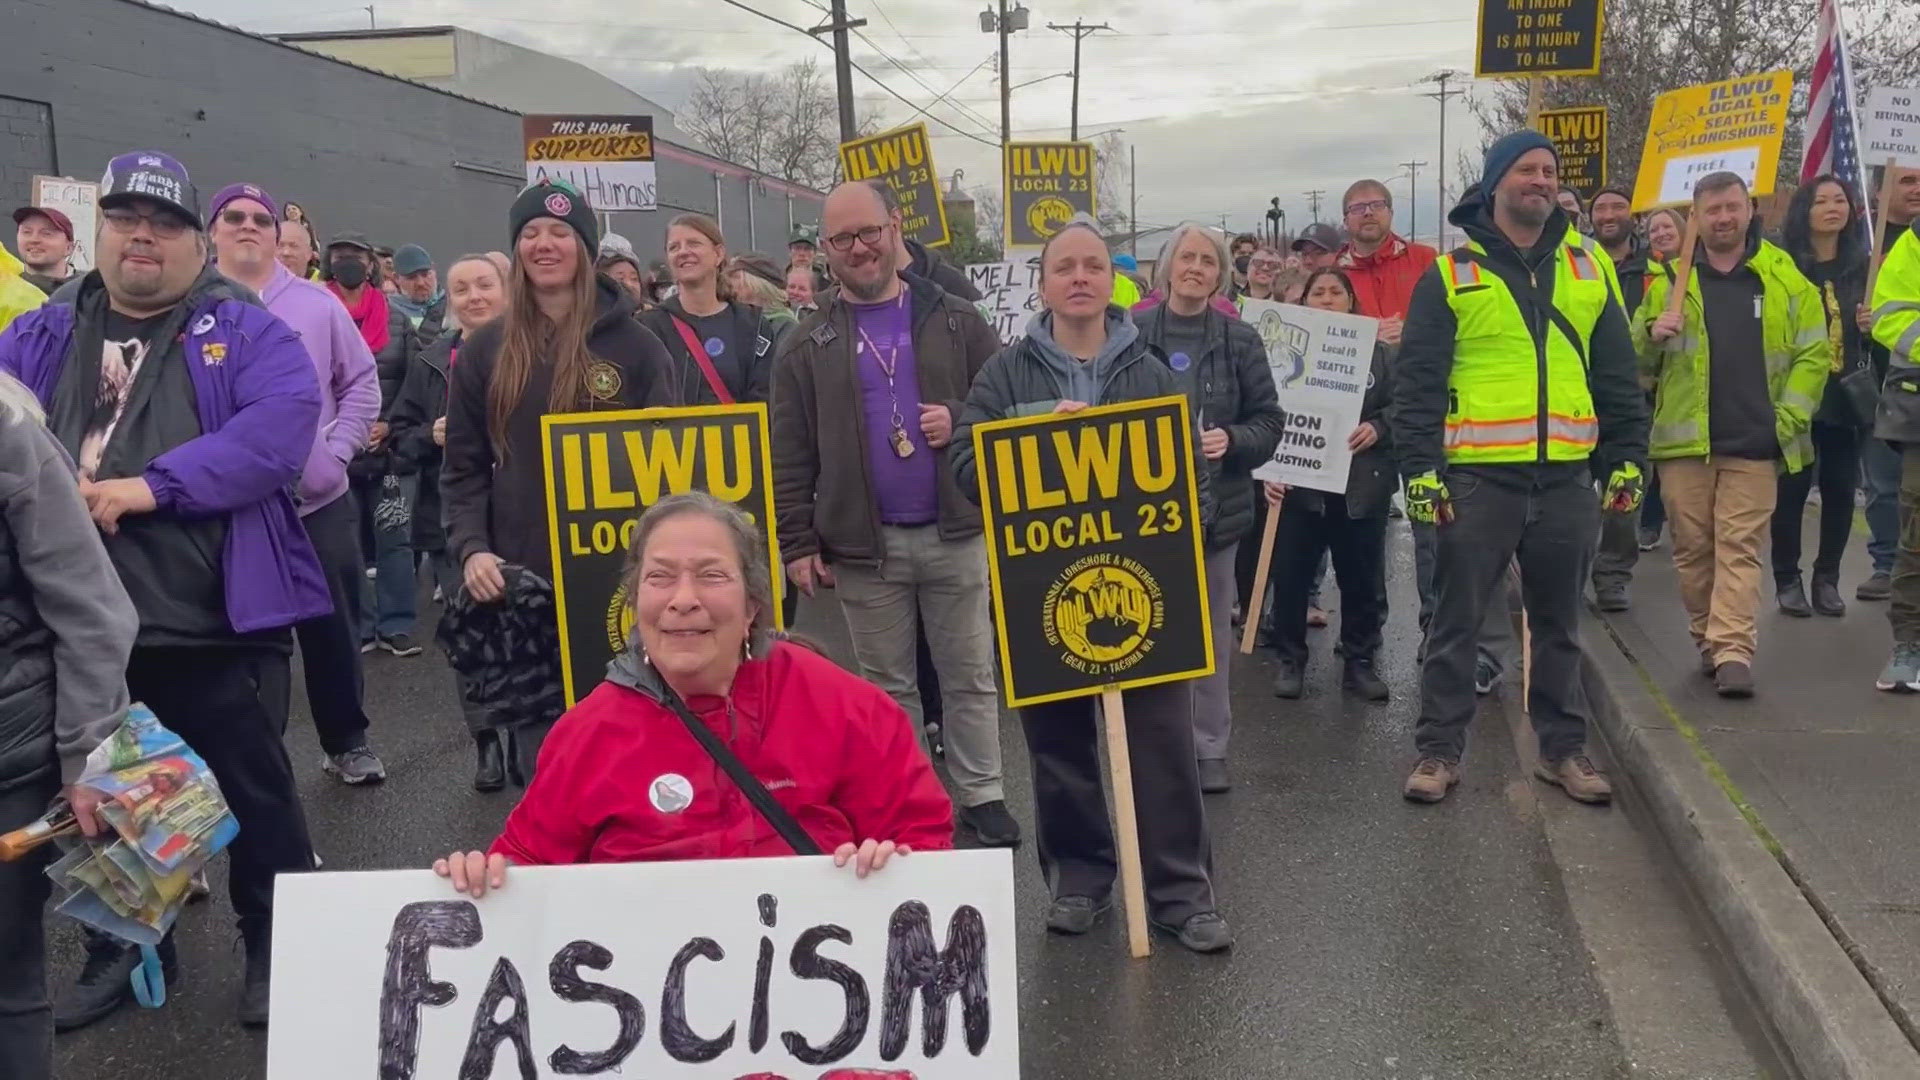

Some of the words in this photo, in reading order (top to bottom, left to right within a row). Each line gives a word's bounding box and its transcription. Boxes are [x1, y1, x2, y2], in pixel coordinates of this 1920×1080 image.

[1516, 14, 1532, 29] TO
[1537, 13, 1564, 28] ONE
[1497, 34, 1510, 48] IS
[1514, 33, 1531, 48] AN
[1536, 31, 1580, 47] INJURY
[1516, 52, 1532, 67] TO
[1536, 51, 1559, 65] ALL
[1711, 77, 1774, 102] ILWU
[1697, 99, 1756, 117] LOCAL
[1761, 93, 1781, 106] 19
[1892, 96, 1911, 107] NO
[551, 121, 586, 135] THIS
[587, 122, 633, 135] HOME
[1705, 109, 1768, 130] SEATTLE
[1690, 122, 1778, 146] LONGSHORE
[1890, 127, 1904, 138] IS
[531, 134, 648, 161] SUPPORTS
[848, 131, 924, 181] ILWU
[1584, 142, 1601, 154] 23
[1870, 141, 1919, 154] ILLEGAL
[1012, 148, 1087, 176] ILWU
[909, 168, 929, 185] 23
[1014, 179, 1063, 192] LOCAL
[1069, 179, 1089, 192] 23
[900, 190, 918, 204] URY
[1316, 360, 1356, 375] SEATTLE
[1305, 376, 1360, 394] LONGSHORE
[1287, 412, 1322, 430] ION
[1283, 431, 1327, 450] TING
[562, 423, 753, 511] ILWU
[993, 415, 1177, 515] ILWU
[1275, 453, 1322, 470] USTING
[1003, 509, 1124, 557] LOCAL
[1138, 499, 1183, 537] 23
[569, 518, 640, 557] LOC
